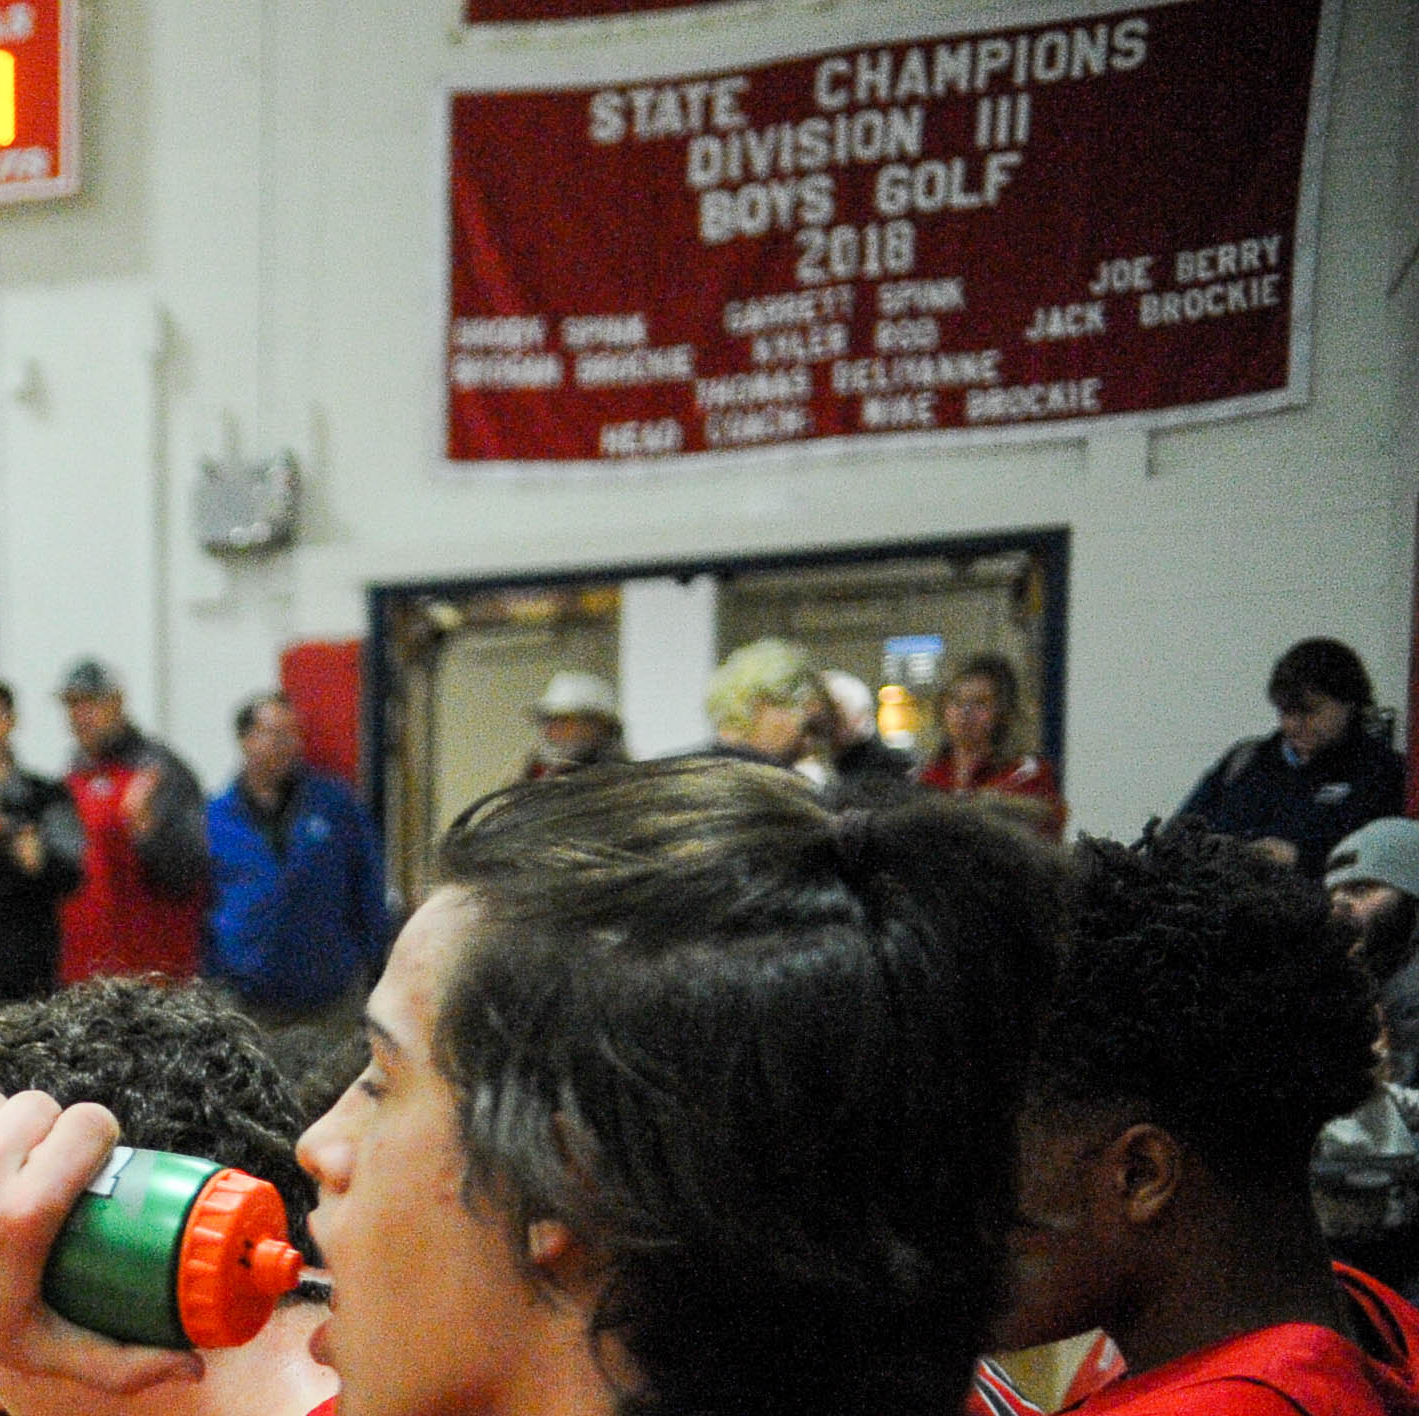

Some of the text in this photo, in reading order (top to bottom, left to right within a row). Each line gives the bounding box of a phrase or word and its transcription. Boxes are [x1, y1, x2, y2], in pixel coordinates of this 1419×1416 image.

[589, 18, 1150, 144] STATE CHAMPIONS
[686, 95, 1033, 190] DIVISION III
[699, 152, 1022, 246] BOYS GOLF
[794, 219, 916, 287] 2018
[1088, 235, 1282, 297] JOE BERRY
[1024, 273, 1282, 344] JACK BROCKIE
